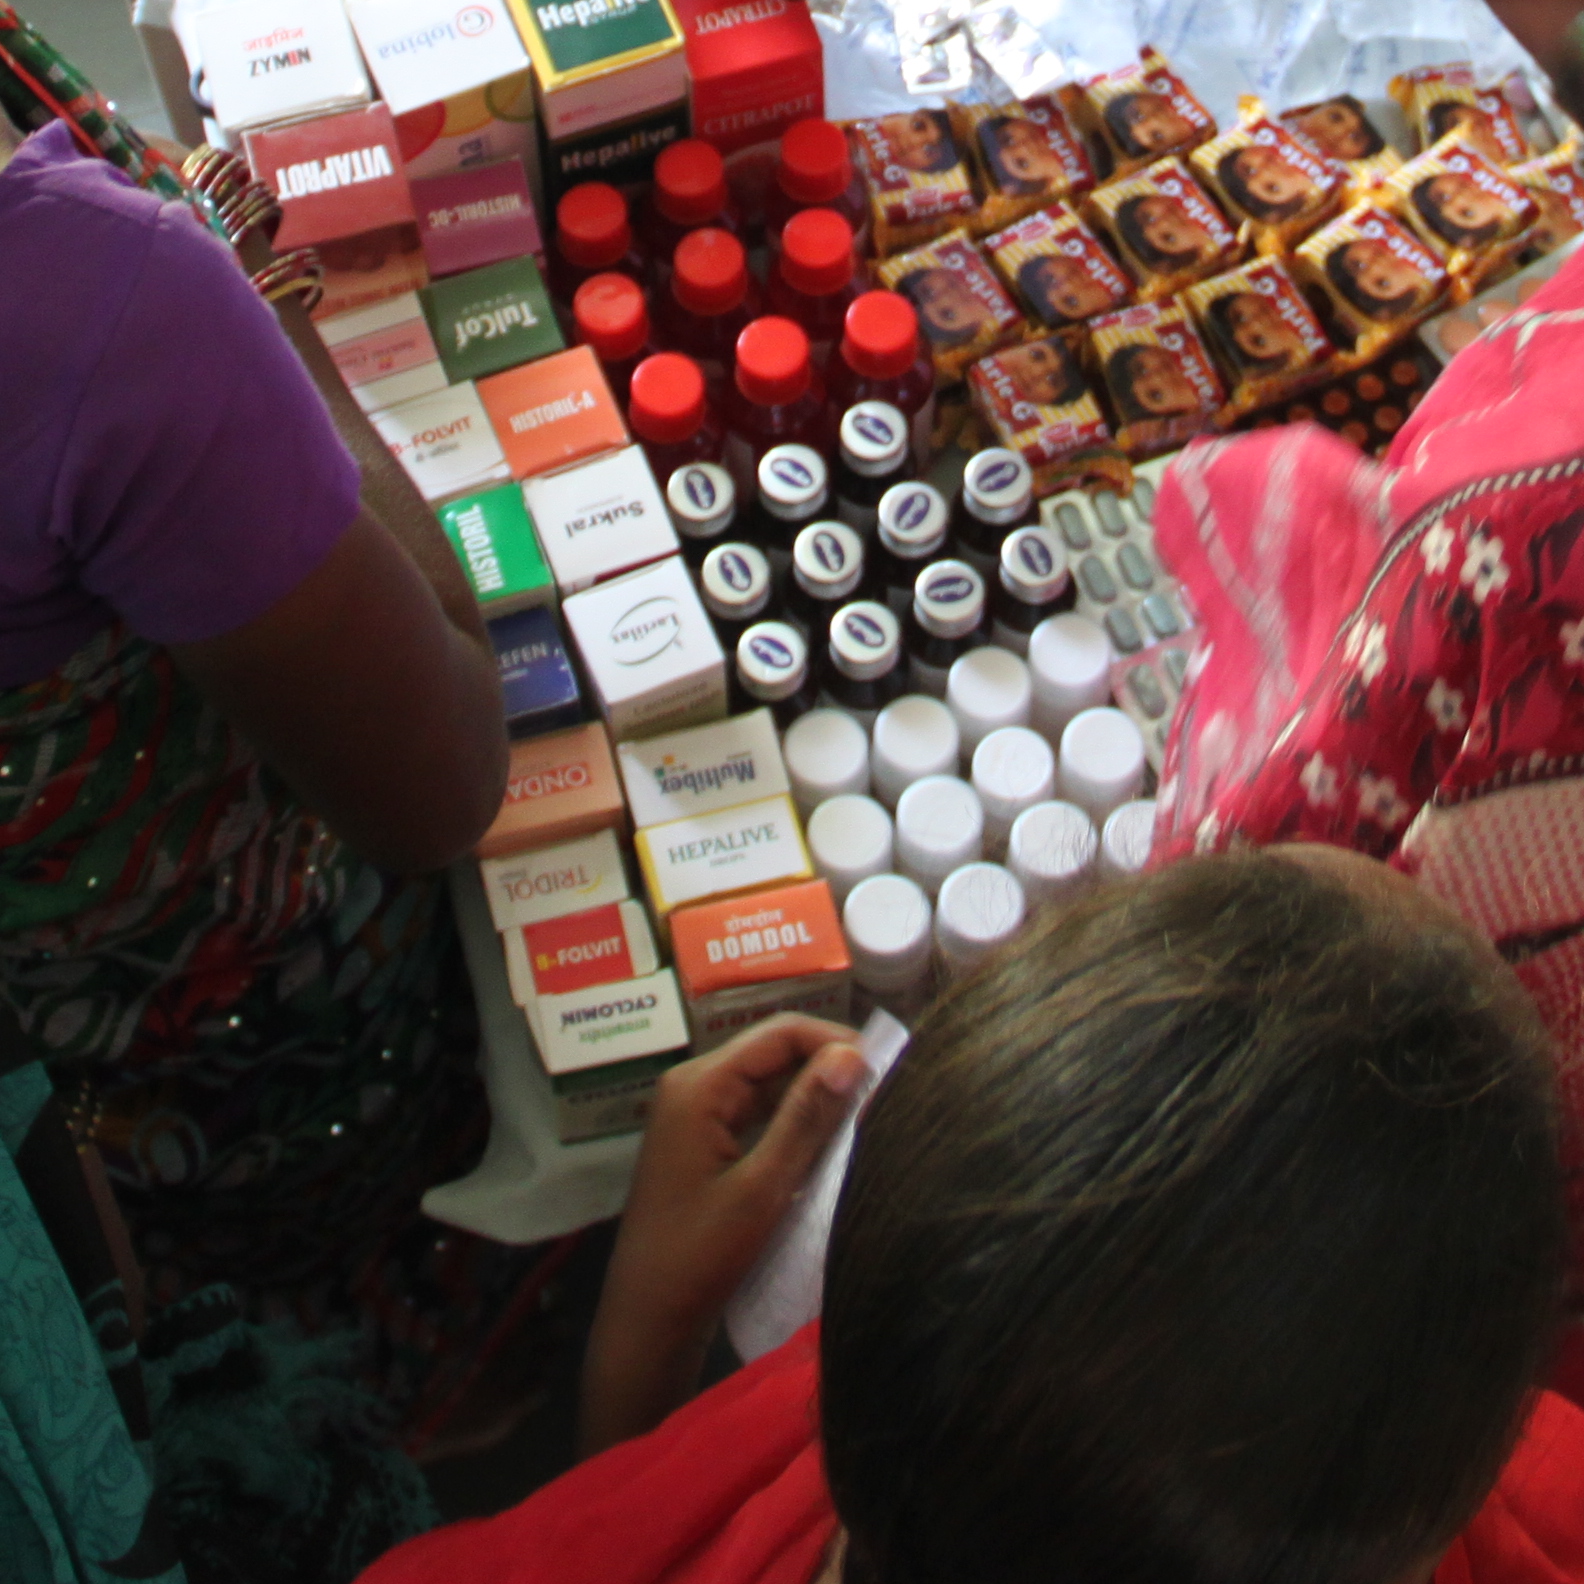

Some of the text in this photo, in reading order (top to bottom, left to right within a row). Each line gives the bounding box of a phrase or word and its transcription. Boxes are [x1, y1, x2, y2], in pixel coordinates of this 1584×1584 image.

[248, 46, 313, 78] ZYMIN
[1149, 77, 1209, 128] arle-G
[275, 144, 394, 202] VITAPROT
[560, 124, 677, 172] Hepalive
[1254, 126, 1336, 190] Parle-G
[1446, 154, 1531, 212] Parle-G
[1160, 176, 1235, 247] Parle-G
[1061, 237, 1125, 297] arle-G
[1361, 218, 1447, 283] Parle-G
[942, 251, 1016, 328] Parle-G
[1253, 275, 1327, 354] Parle-G
[454, 300, 539, 353] TulCof
[508, 390, 597, 434] HISTORIL-A
[977, 355, 1037, 420] arle-G
[564, 500, 646, 538] Sukral
[455, 502, 507, 594] HISTORIL
[498, 641, 548, 668] EFEN
[660, 757, 756, 795] Multibex
[667, 822, 780, 865] HEPALIVE
[502, 864, 591, 903] TRIDOL
[536, 936, 621, 972] B-FOLVIT
[705, 920, 814, 965] DOMDOL
[560, 993, 658, 1032] CYCLOMIN
